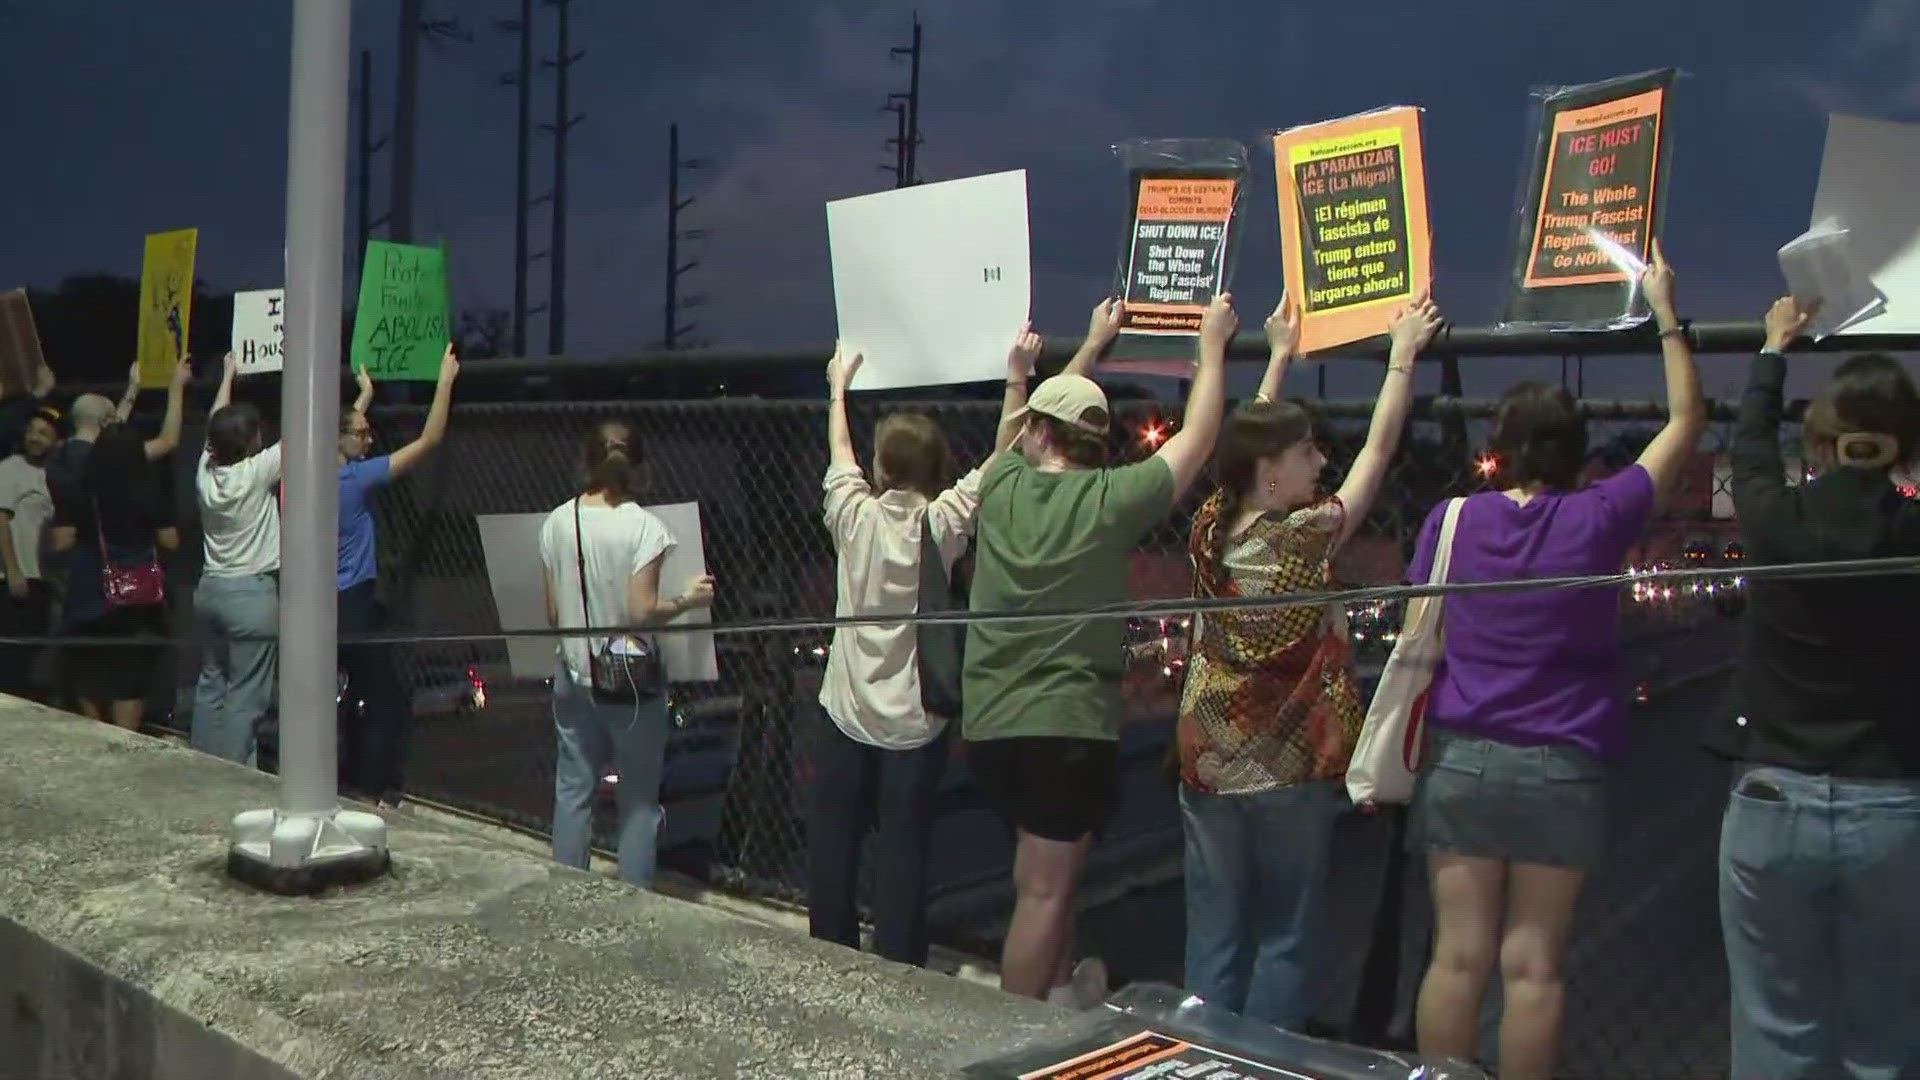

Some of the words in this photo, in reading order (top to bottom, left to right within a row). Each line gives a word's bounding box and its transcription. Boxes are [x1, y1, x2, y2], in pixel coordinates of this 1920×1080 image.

[1569, 134, 1596, 154] ICE
[1599, 124, 1640, 151] MUST
[1320, 148, 1394, 176] PARALIZAR
[1589, 154, 1616, 176] GO!
[1302, 178, 1325, 197] ICE
[1328, 176, 1348, 195] (La
[1351, 165, 1396, 188] Migra)!
[1561, 190, 1589, 206] The
[1593, 185, 1637, 204] Whole
[1335, 198, 1386, 220] régimen
[1544, 213, 1588, 229] Trump
[1591, 205, 1643, 225] Fascist
[1138, 225, 1166, 238] SHUT
[1167, 225, 1198, 239] DOWN
[1200, 226, 1222, 240] ICE!
[1319, 220, 1371, 242] fascista
[1373, 215, 1390, 232] de
[1149, 245, 1173, 258] Shut
[1175, 245, 1204, 259] Down
[1313, 247, 1352, 265] Trump
[1354, 239, 1396, 259] entero
[1553, 255, 1572, 268] Go
[1574, 250, 1612, 267] NOW
[1148, 259, 1165, 272] the
[1168, 259, 1202, 273] Whole
[1327, 265, 1359, 282] tiene
[1361, 261, 1384, 279] que
[1137, 271, 1168, 288] Trump
[1171, 273, 1211, 288] Fascist
[1309, 284, 1361, 305] largarse
[1363, 271, 1404, 294] ahora!
[1149, 287, 1194, 302] Regime!
[367, 345, 415, 373] ICE
